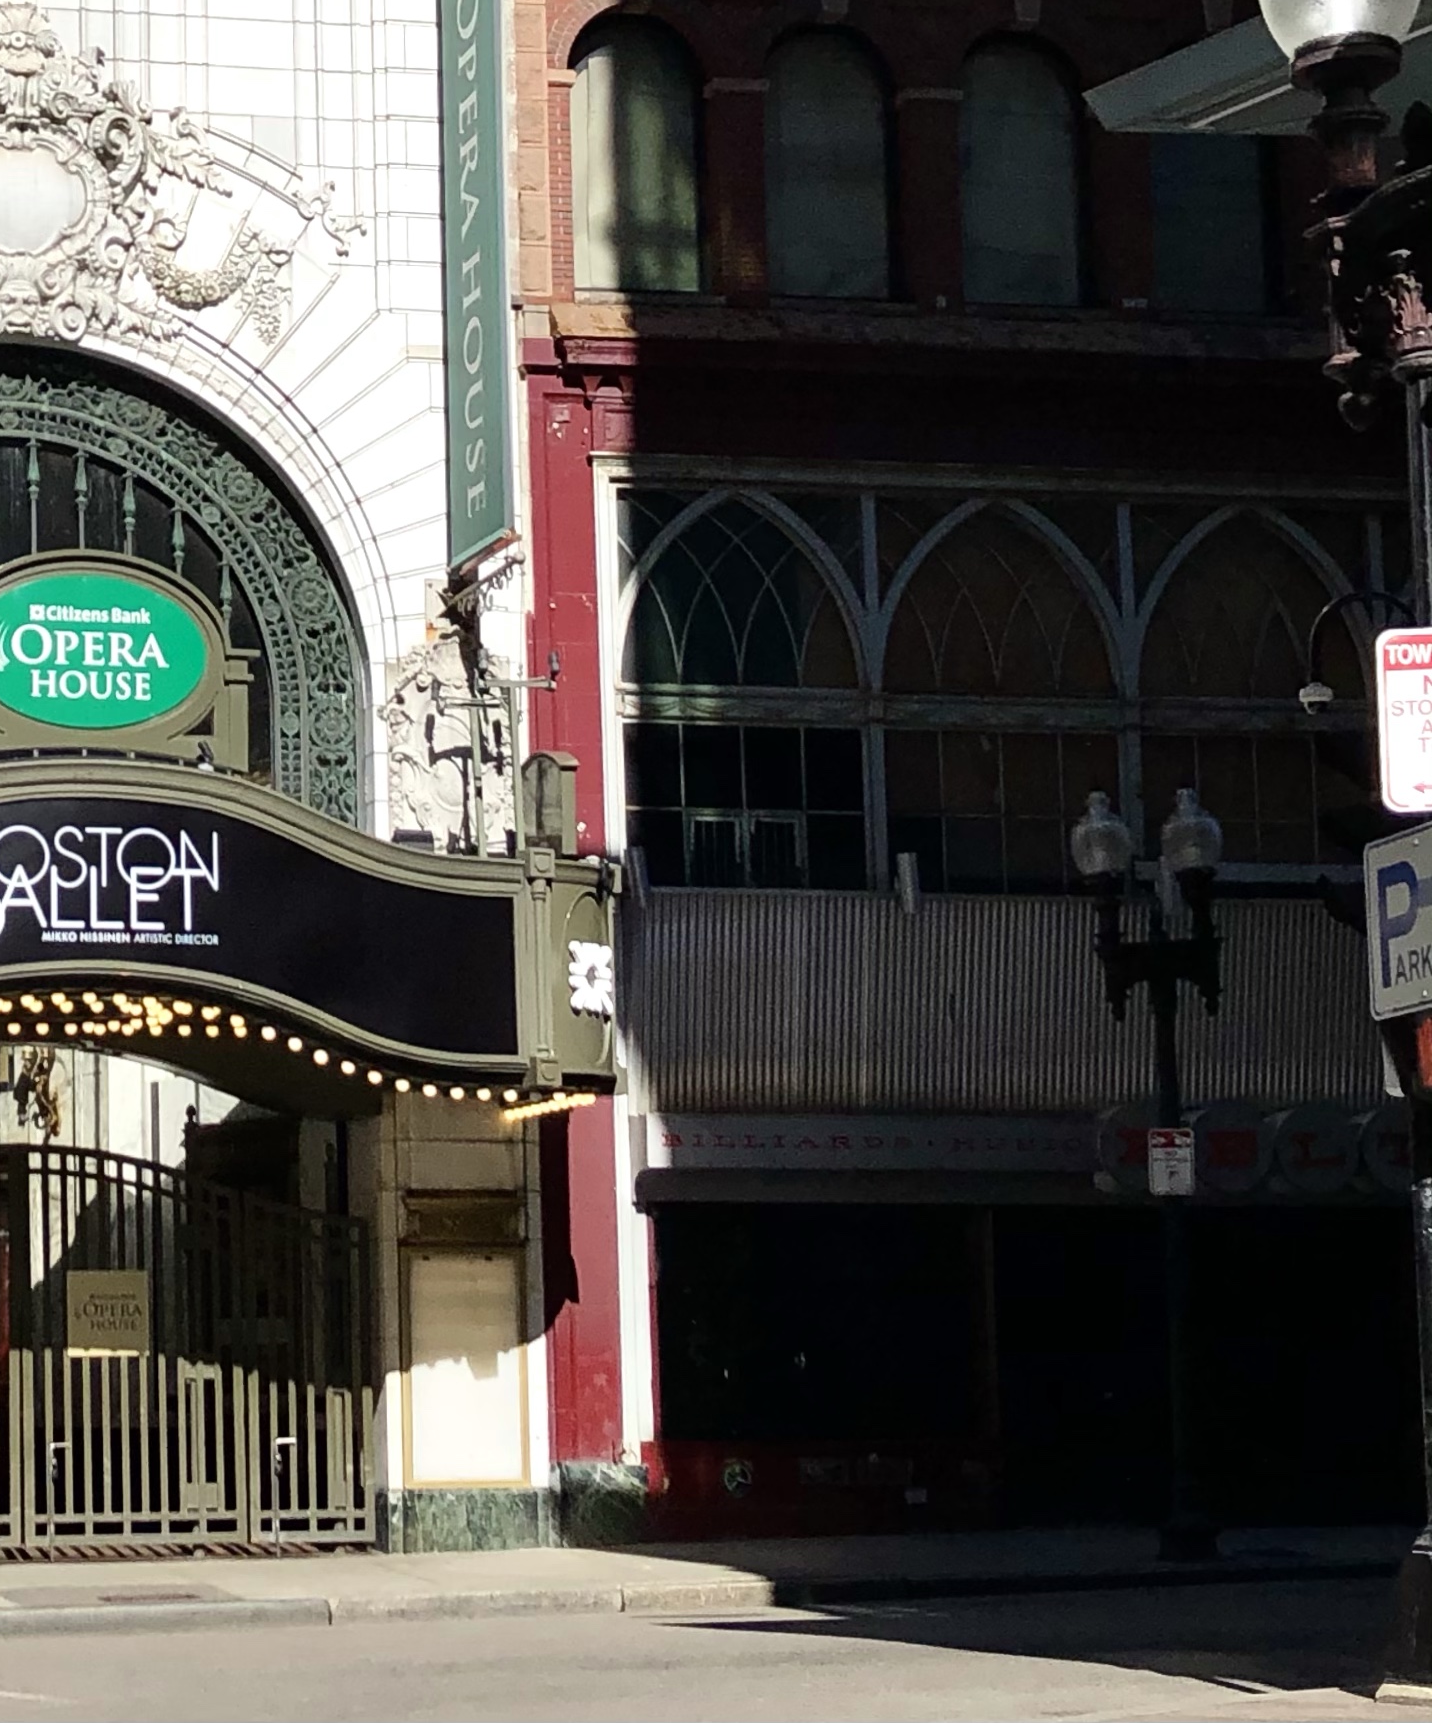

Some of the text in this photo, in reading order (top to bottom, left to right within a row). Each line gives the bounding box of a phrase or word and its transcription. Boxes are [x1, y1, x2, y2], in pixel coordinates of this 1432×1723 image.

[461, 250, 487, 519] HOUSE
[46, 605, 151, 624] Citizens Bank
[11, 623, 169, 668] OPERA
[1385, 643, 1432, 665] TOW
[30, 669, 151, 700] HOUSE
[41, 931, 219, 945] MIKKO NISSINEN ARTISTIC DIRECTOR
